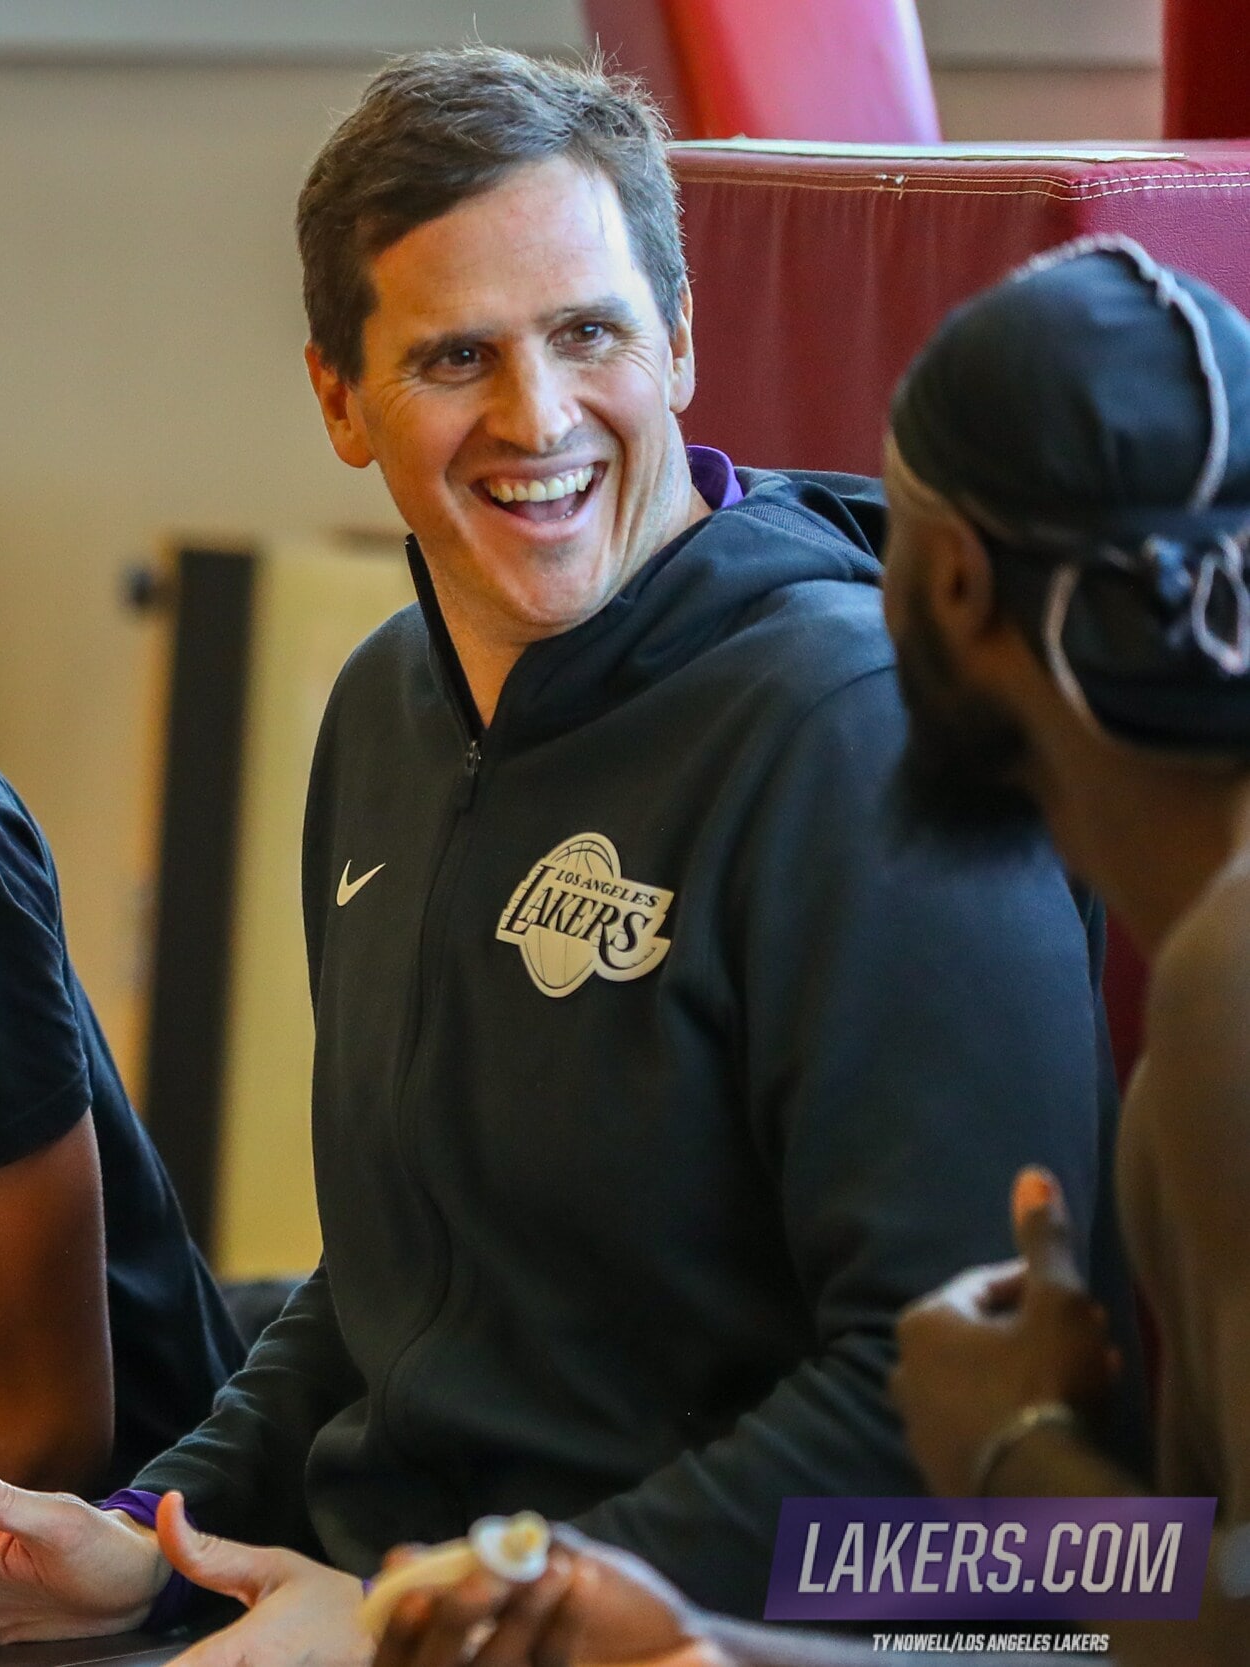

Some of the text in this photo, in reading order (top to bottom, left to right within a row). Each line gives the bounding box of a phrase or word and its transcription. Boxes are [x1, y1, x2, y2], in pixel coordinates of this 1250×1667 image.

[500, 864, 657, 970] LAKERS
[555, 869, 660, 908] LOS ANGELES
